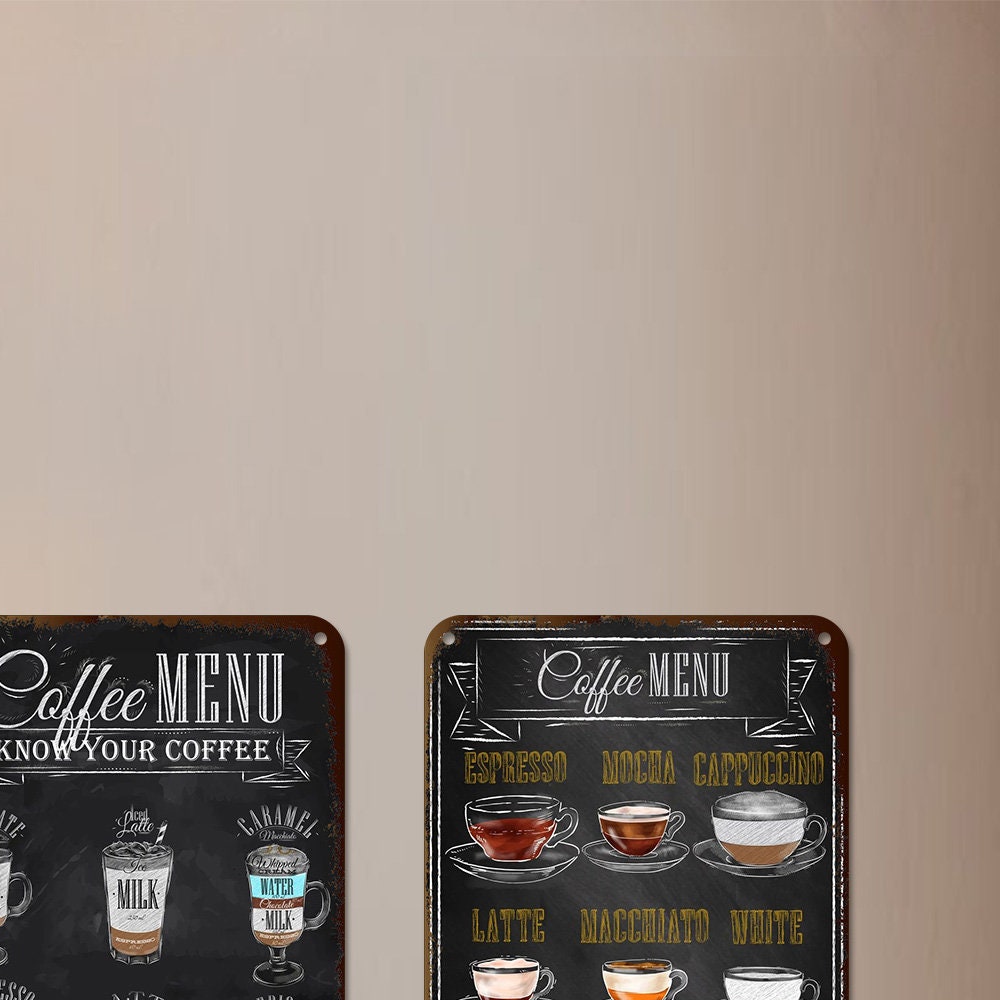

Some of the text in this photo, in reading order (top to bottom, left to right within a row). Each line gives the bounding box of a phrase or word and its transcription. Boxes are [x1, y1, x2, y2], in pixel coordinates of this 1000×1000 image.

[156, 653, 285, 723] MENU
[537, 648, 730, 714] Coffee MENU
[86, 737, 155, 763] YOUR
[166, 739, 271, 761] COFFEE
[464, 750, 568, 784] ESPRESSO
[602, 750, 676, 785] MOCHA
[693, 750, 824, 786] CAPPUCCINO
[115, 811, 155, 838] Latte
[237, 804, 319, 839] CARAMEL
[123, 855, 147, 873] Ice
[252, 855, 299, 870] Whipped
[117, 879, 159, 909] MILK
[260, 878, 294, 895] WATER
[260, 899, 295, 909] Chocolate
[265, 910, 292, 930] MILK
[471, 908, 545, 943] LATTE
[580, 908, 709, 944] MACCHIATO
[729, 909, 803, 945] WHITE
